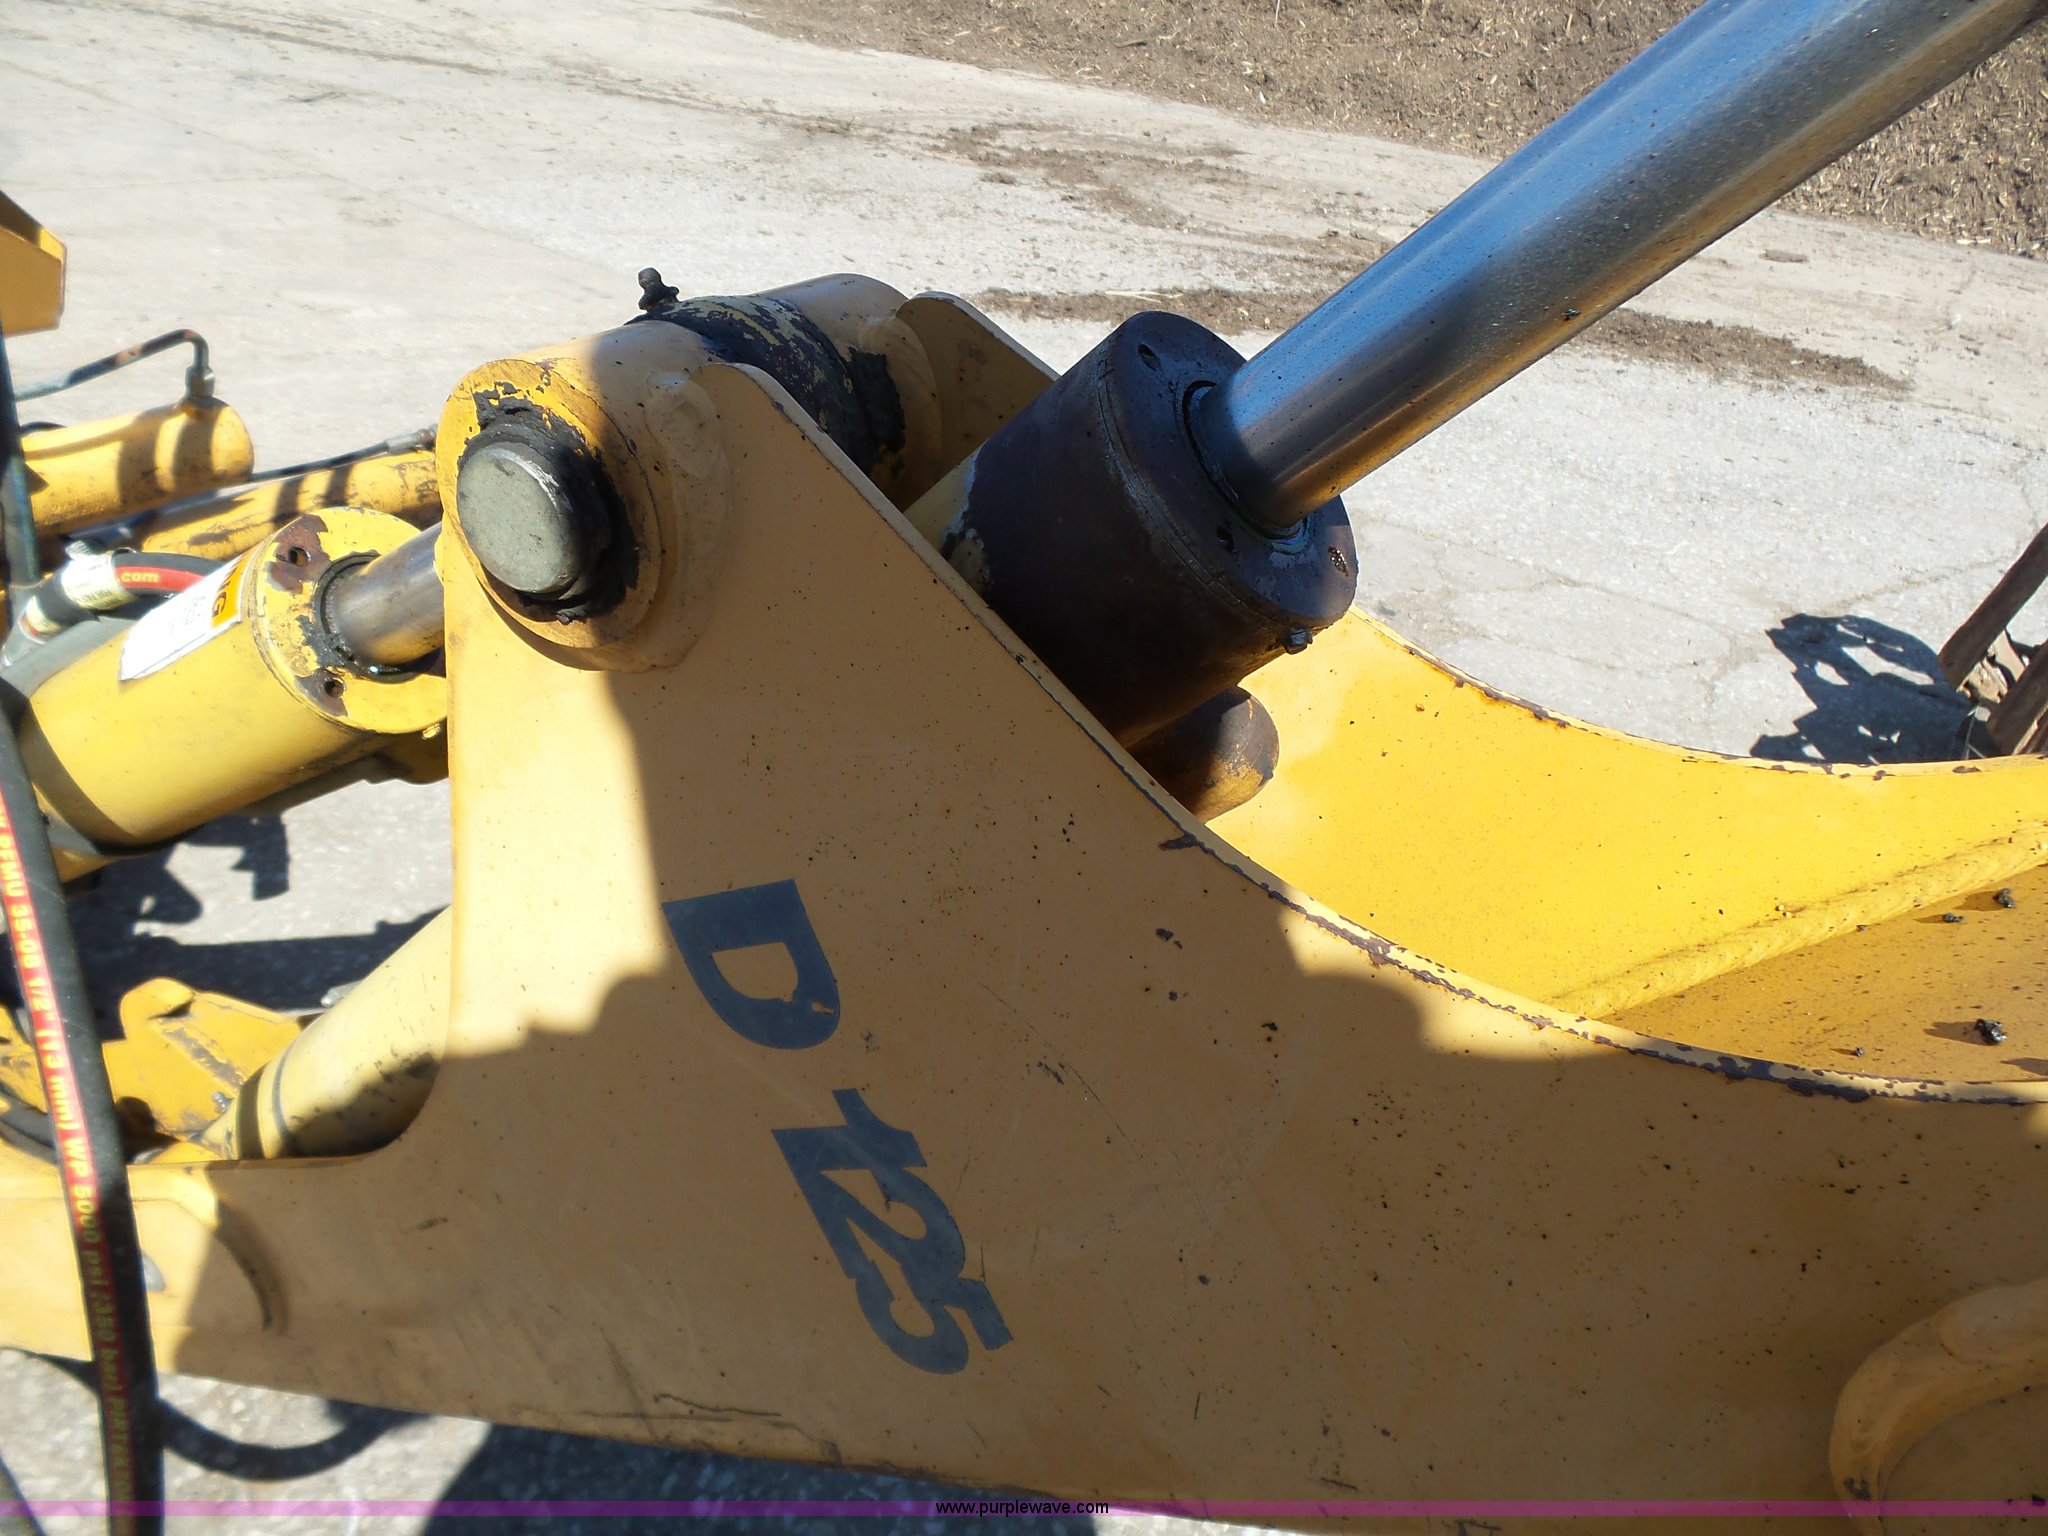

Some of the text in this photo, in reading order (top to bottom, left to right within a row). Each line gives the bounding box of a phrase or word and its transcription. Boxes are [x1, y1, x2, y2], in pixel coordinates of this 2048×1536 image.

[36, 1029, 64, 1069] (13
[49, 1075, 81, 1130] mm)
[661, 879, 1014, 1375] D 125
[65, 1137, 95, 1178] WP
[73, 1184, 100, 1244] 5000
[83, 1250, 109, 1286] psi
